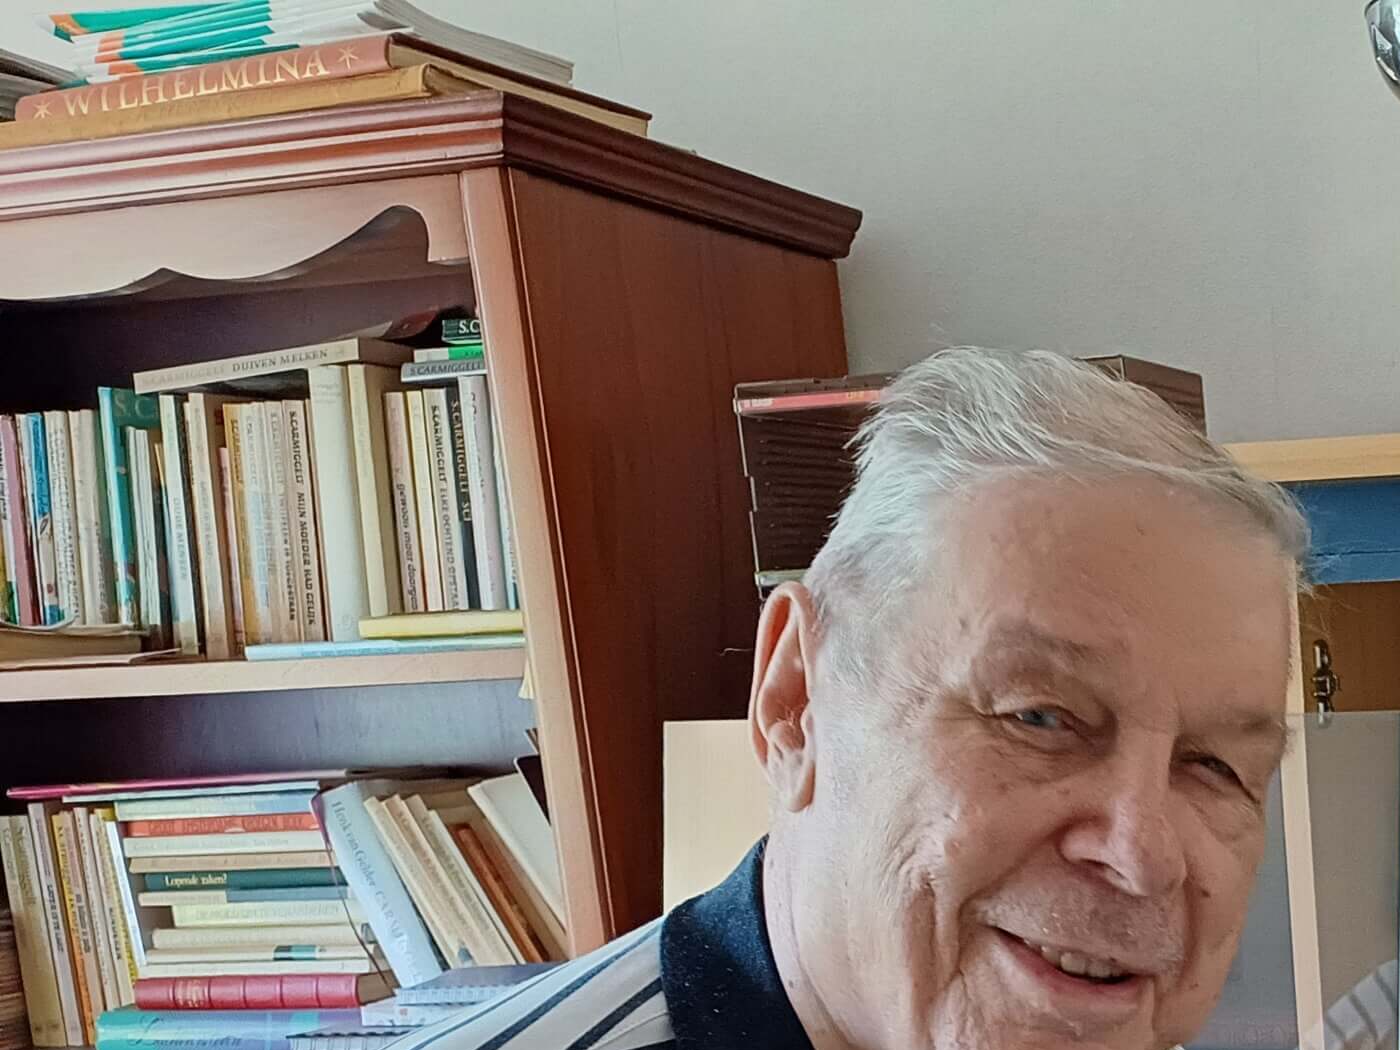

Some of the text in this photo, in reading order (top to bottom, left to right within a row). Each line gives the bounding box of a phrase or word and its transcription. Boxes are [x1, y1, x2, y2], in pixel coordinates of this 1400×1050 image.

[64, 53, 330, 118] WILHELMINA
[232, 358, 277, 373] DUIVEN
[279, 349, 328, 366] MELKEN
[296, 491, 307, 519] MIJN
[299, 520, 311, 566] MOEDER
